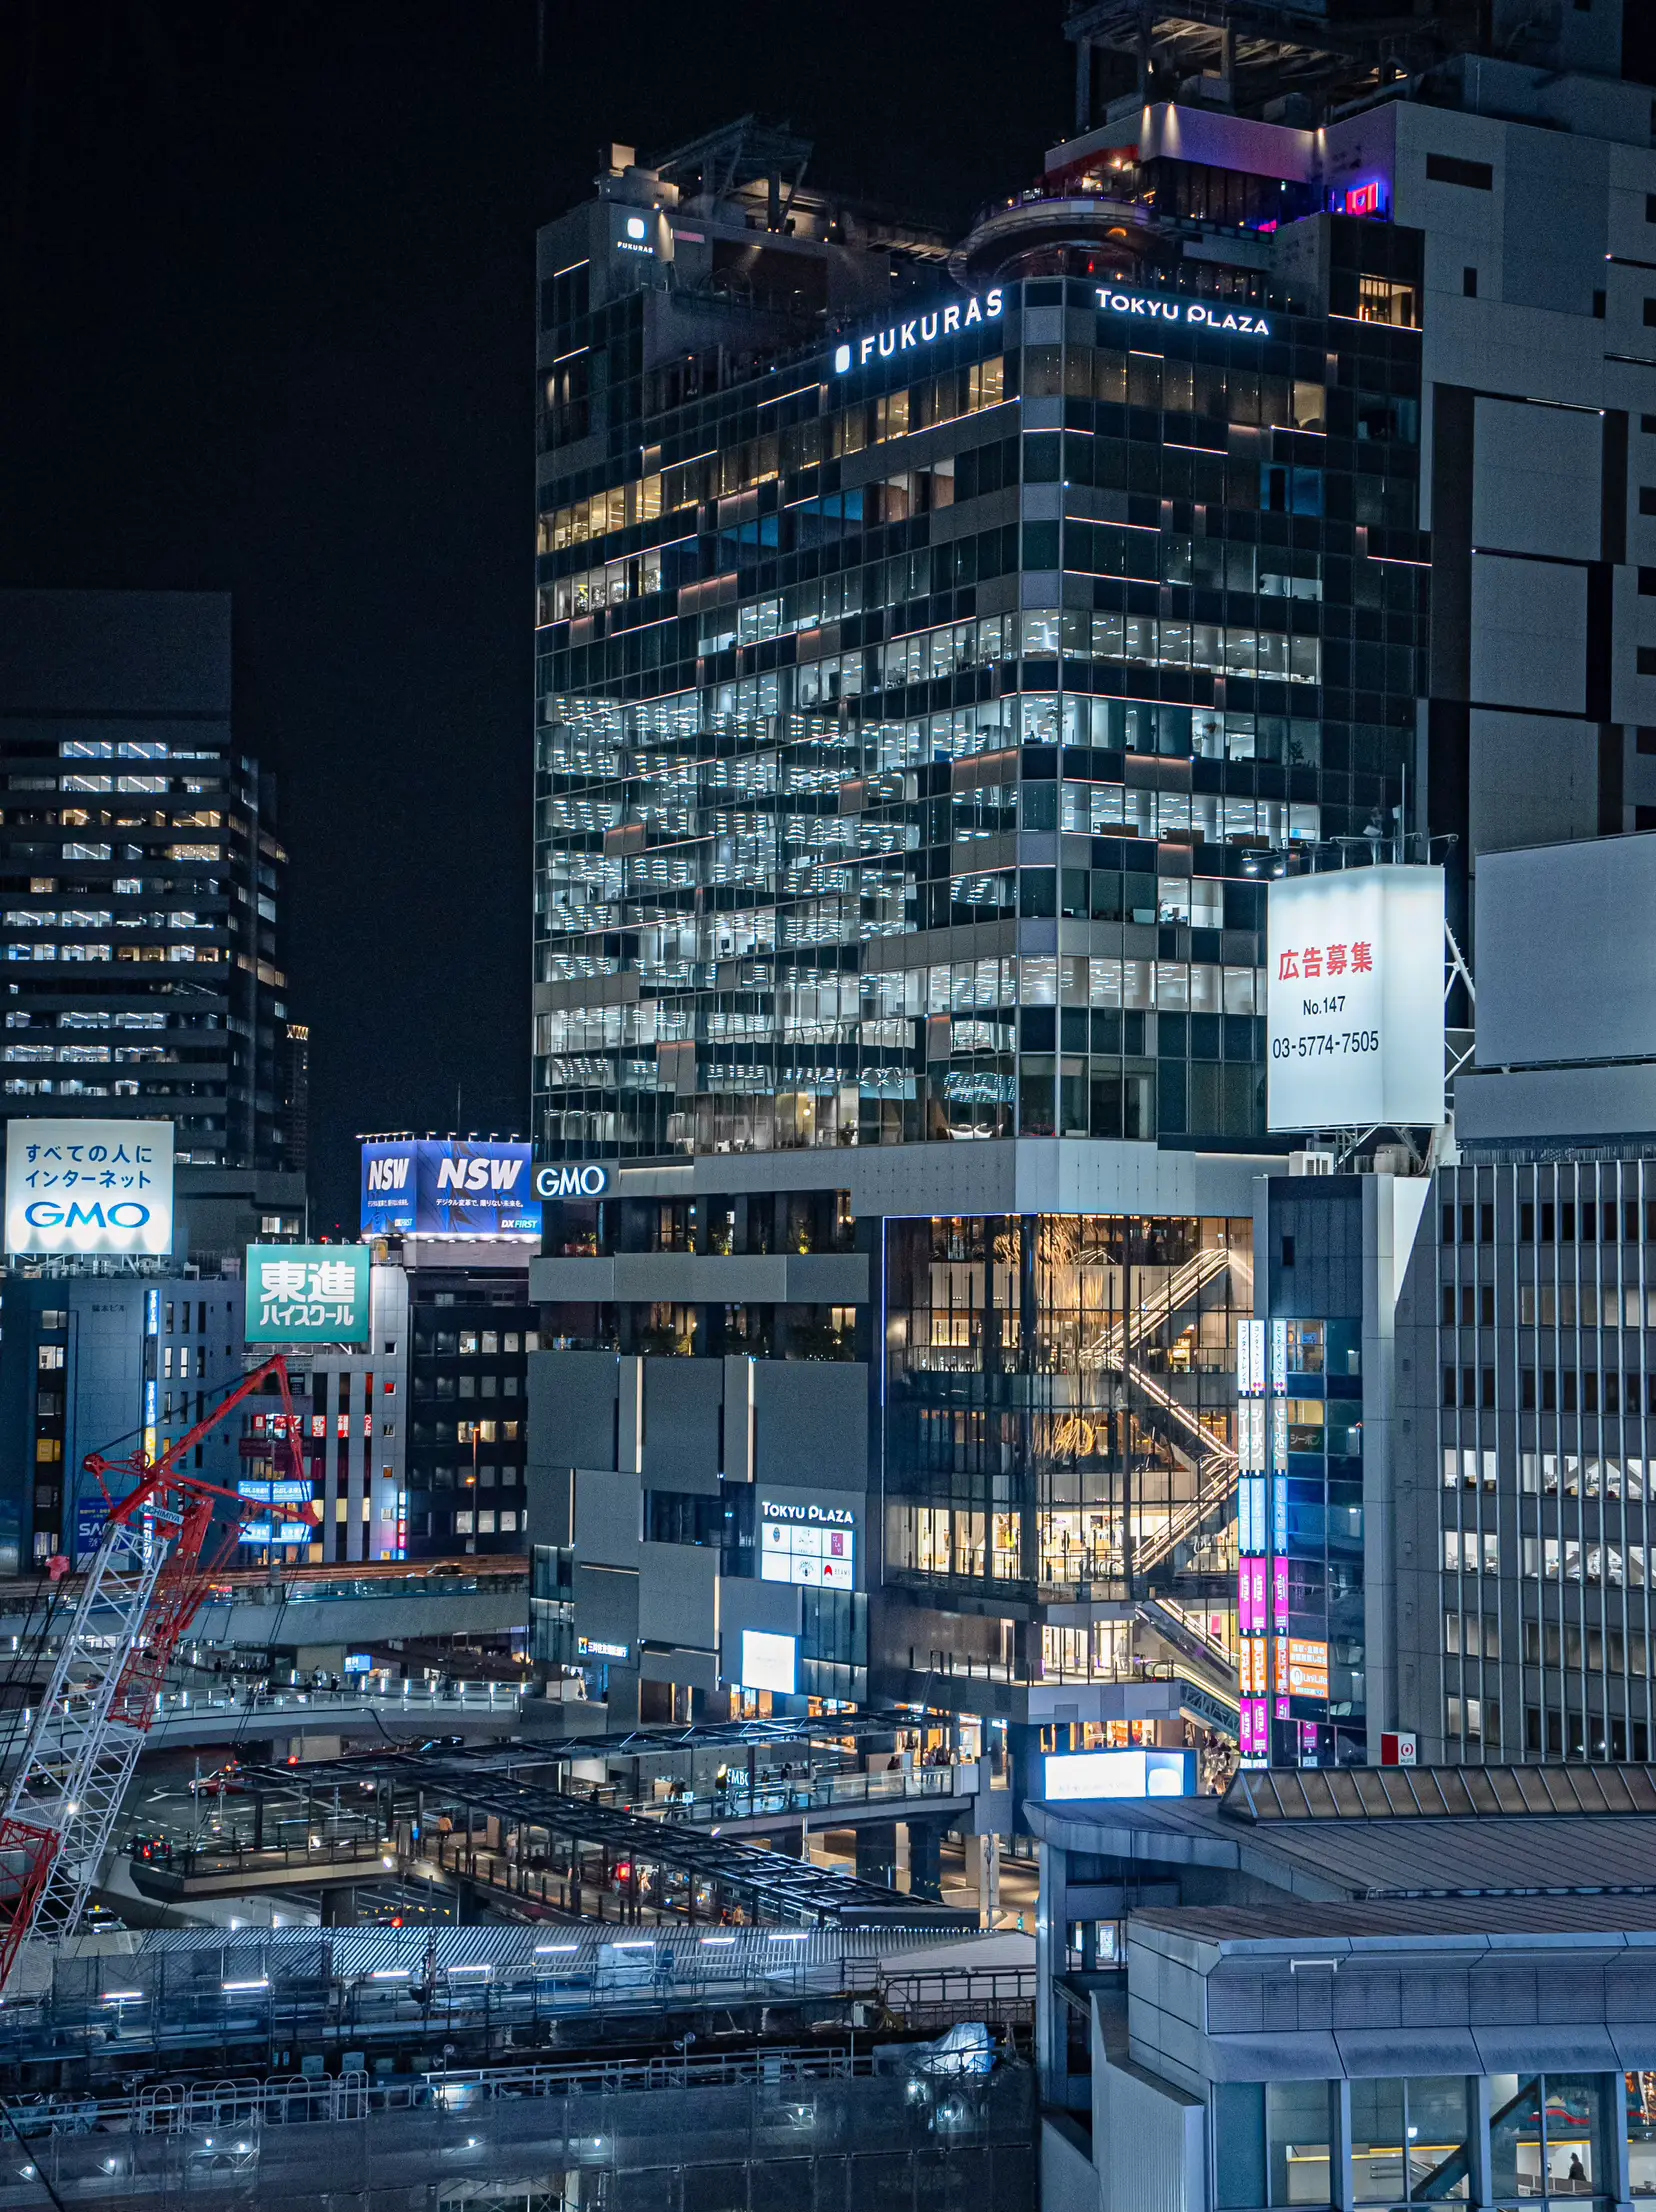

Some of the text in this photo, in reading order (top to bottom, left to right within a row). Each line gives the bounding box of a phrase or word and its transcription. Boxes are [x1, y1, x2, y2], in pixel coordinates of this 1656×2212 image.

[617, 241, 653, 254] FUKURAS
[1095, 288, 1269, 336] TOKYU PLAZA
[861, 288, 1003, 365] FUKURAS
[1278, 941, 1373, 981] 広告募集
[1303, 995, 1346, 1016] No.147
[1272, 1030, 1379, 1059] 03-5774-7505
[25, 1144, 152, 1163] すべての人に
[25, 1169, 151, 1189] インターネット
[368, 1158, 409, 1190] NSW
[437, 1158, 523, 1190] NSW
[536, 1165, 605, 1197] GMO
[25, 1201, 150, 1229] GMO
[514, 1219, 537, 1228] FIRST
[260, 1261, 355, 1303] 東進
[260, 1305, 354, 1326] ハイスクール
[141, 1505, 180, 1523] UCHIMIYA
[762, 1501, 853, 1524] TOKYU PLAZA
